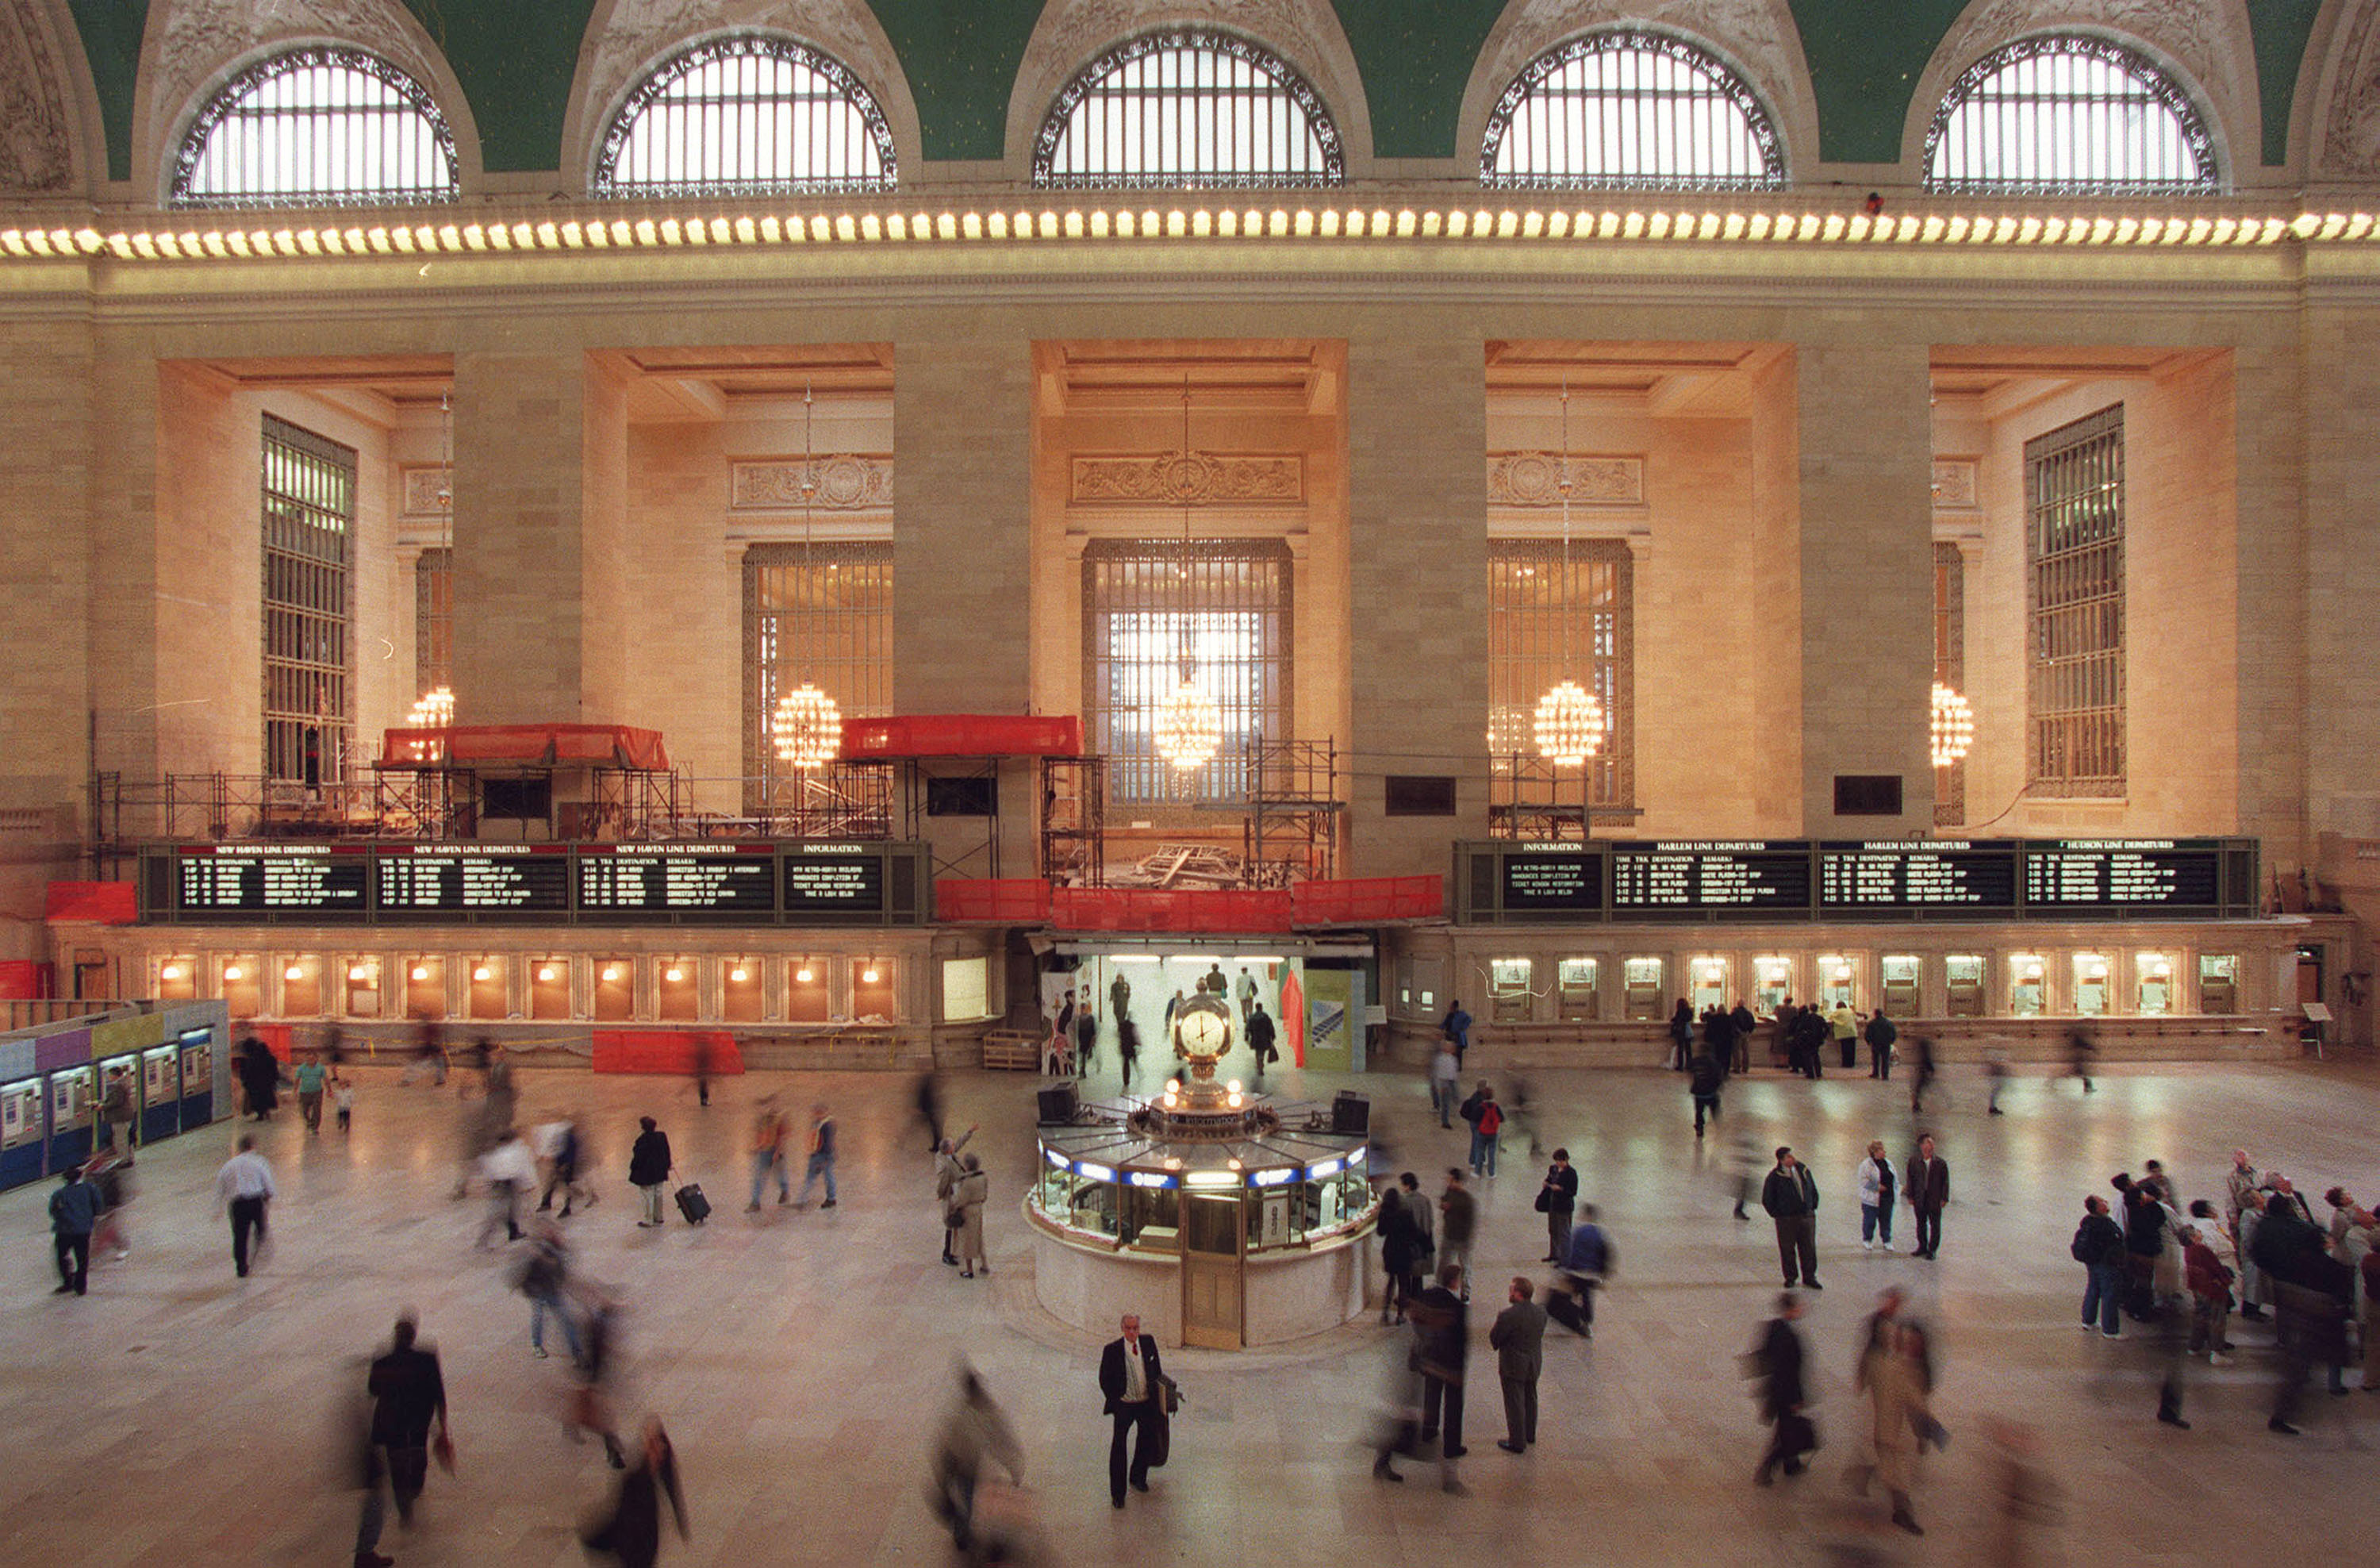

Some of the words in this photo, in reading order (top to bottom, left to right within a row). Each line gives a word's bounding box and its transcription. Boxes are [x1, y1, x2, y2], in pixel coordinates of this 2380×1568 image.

[616, 844, 635, 853] NEW
[636, 844, 664, 853] HAVEN
[666, 844, 685, 853] LINE
[686, 844, 735, 853] DEPARTURES
[803, 844, 862, 853] INFORMATION
[1522, 843, 1583, 851] INFORMATION
[1656, 842, 1692, 851] HARLEM
[1693, 842, 1712, 851] LINE
[1714, 842, 1765, 851] DEPARTURES
[1864, 841, 1898, 850] HARLEM
[1899, 841, 1918, 850] LINE
[1920, 841, 1971, 850] DEPARTURES
[2067, 840, 2103, 849] HUDSON
[2104, 840, 2123, 849] LINE
[2124, 840, 2174, 849] DEPARTURES
[216, 845, 235, 854] NEW
[236, 845, 263, 854] HAVEN
[263, 845, 282, 854] LINE
[283, 845, 331, 854] DEPARTURES
[413, 845, 432, 854] NEW
[434, 845, 461, 854] HAVEN
[463, 845, 481, 854] LINE
[482, 845, 531, 854] DEPARTURES
